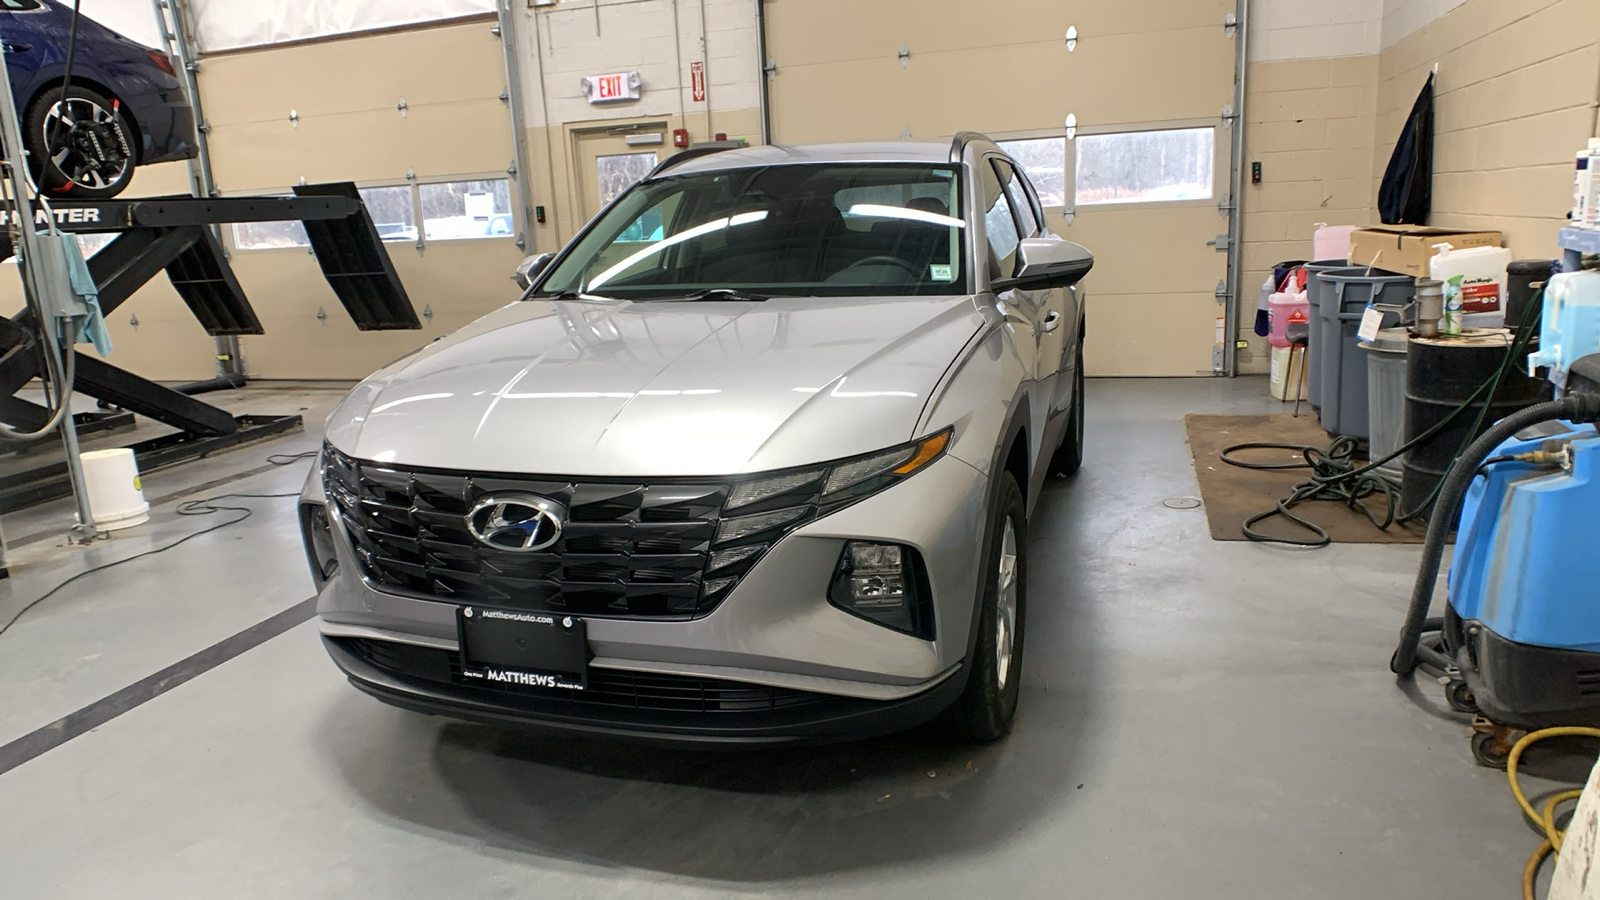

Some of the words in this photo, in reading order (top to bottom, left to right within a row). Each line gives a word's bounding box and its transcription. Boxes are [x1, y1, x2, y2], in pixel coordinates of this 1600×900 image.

[598, 75, 621, 98] EXIT
[0, 207, 99, 225] HNTER
[482, 610, 553, 624] MatthewsAuto.com
[488, 670, 556, 687] MATTHEWS
